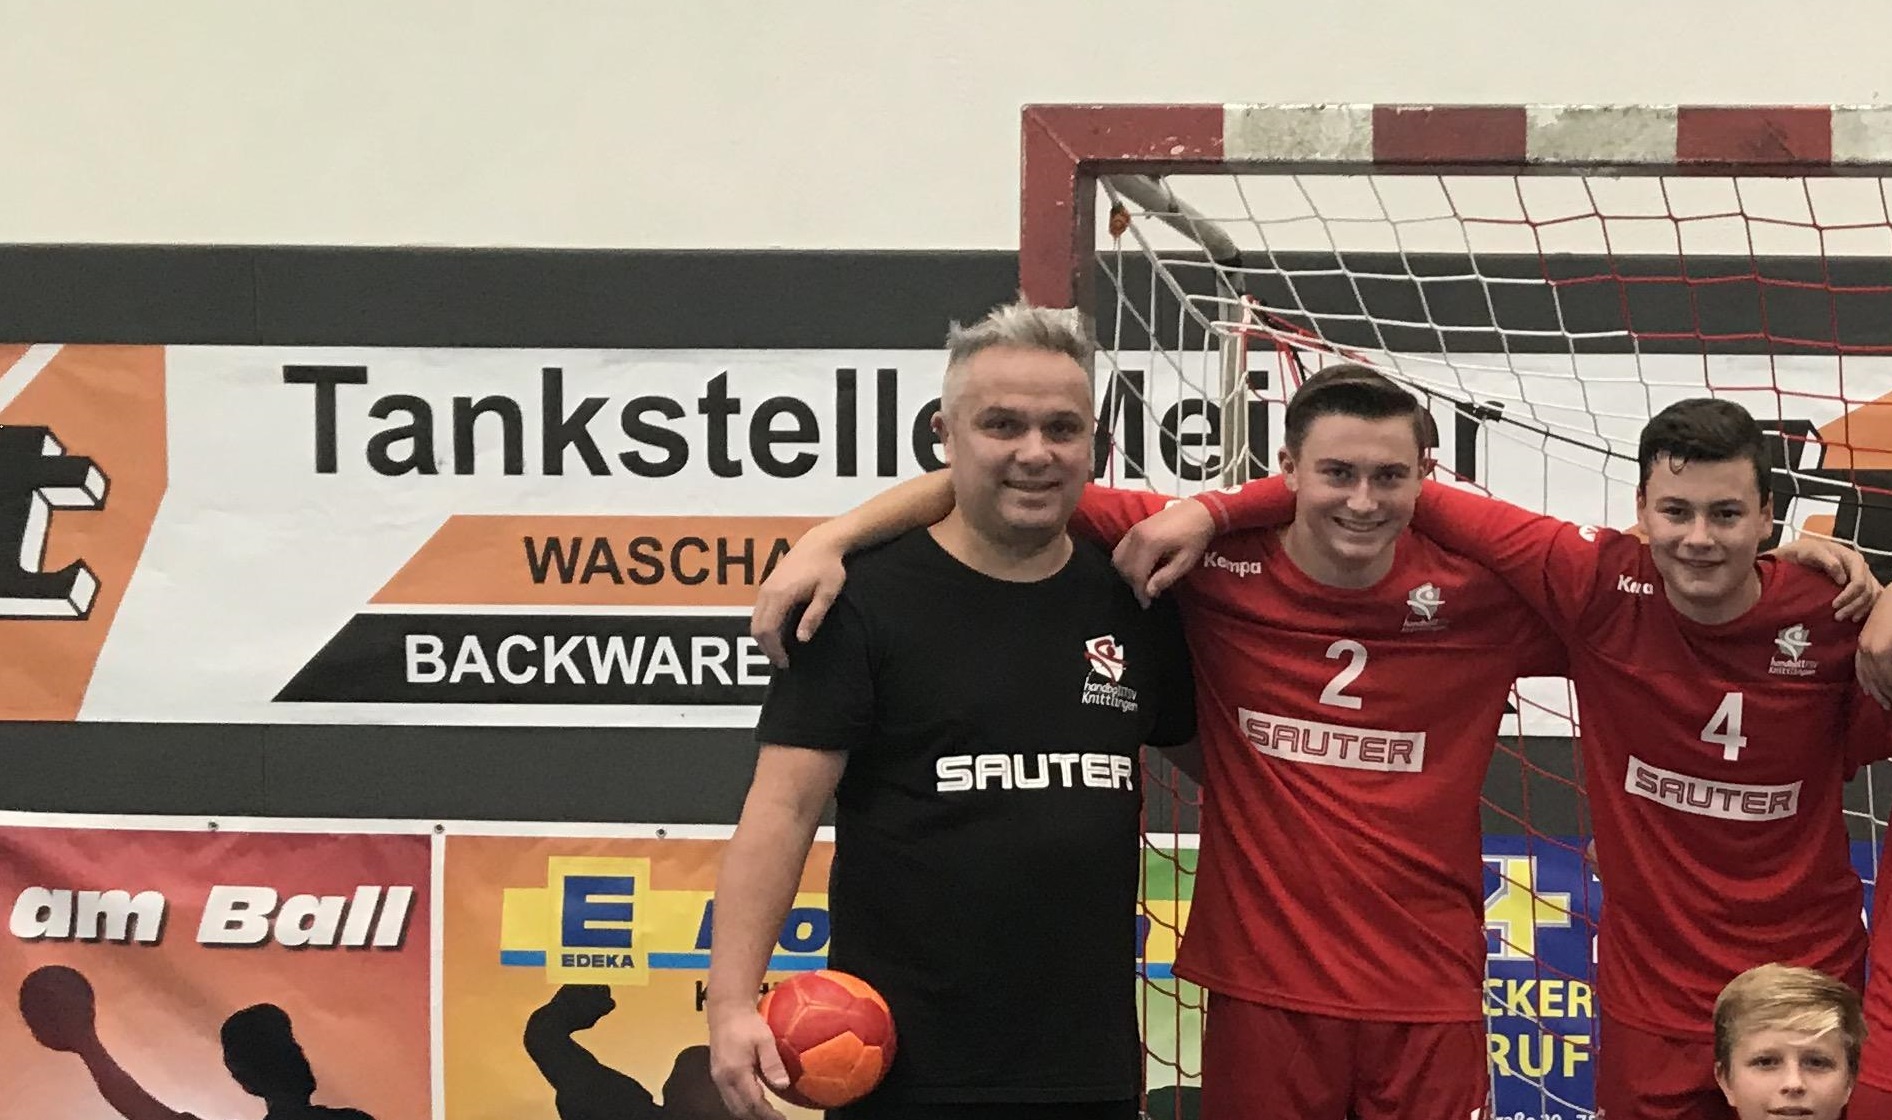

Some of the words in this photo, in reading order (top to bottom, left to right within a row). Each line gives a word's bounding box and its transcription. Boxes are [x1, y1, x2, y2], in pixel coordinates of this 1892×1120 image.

[1203, 551, 1263, 578] Kempa
[1318, 639, 1368, 711] 2
[1246, 720, 1413, 764] SAUTER
[1701, 692, 1748, 762] 4
[936, 753, 1133, 792] SAUTER
[1634, 766, 1796, 815] SAUTER
[9, 885, 165, 941] am
[197, 885, 416, 948] Ball
[562, 875, 635, 948] E
[561, 954, 635, 968] EDEKA
